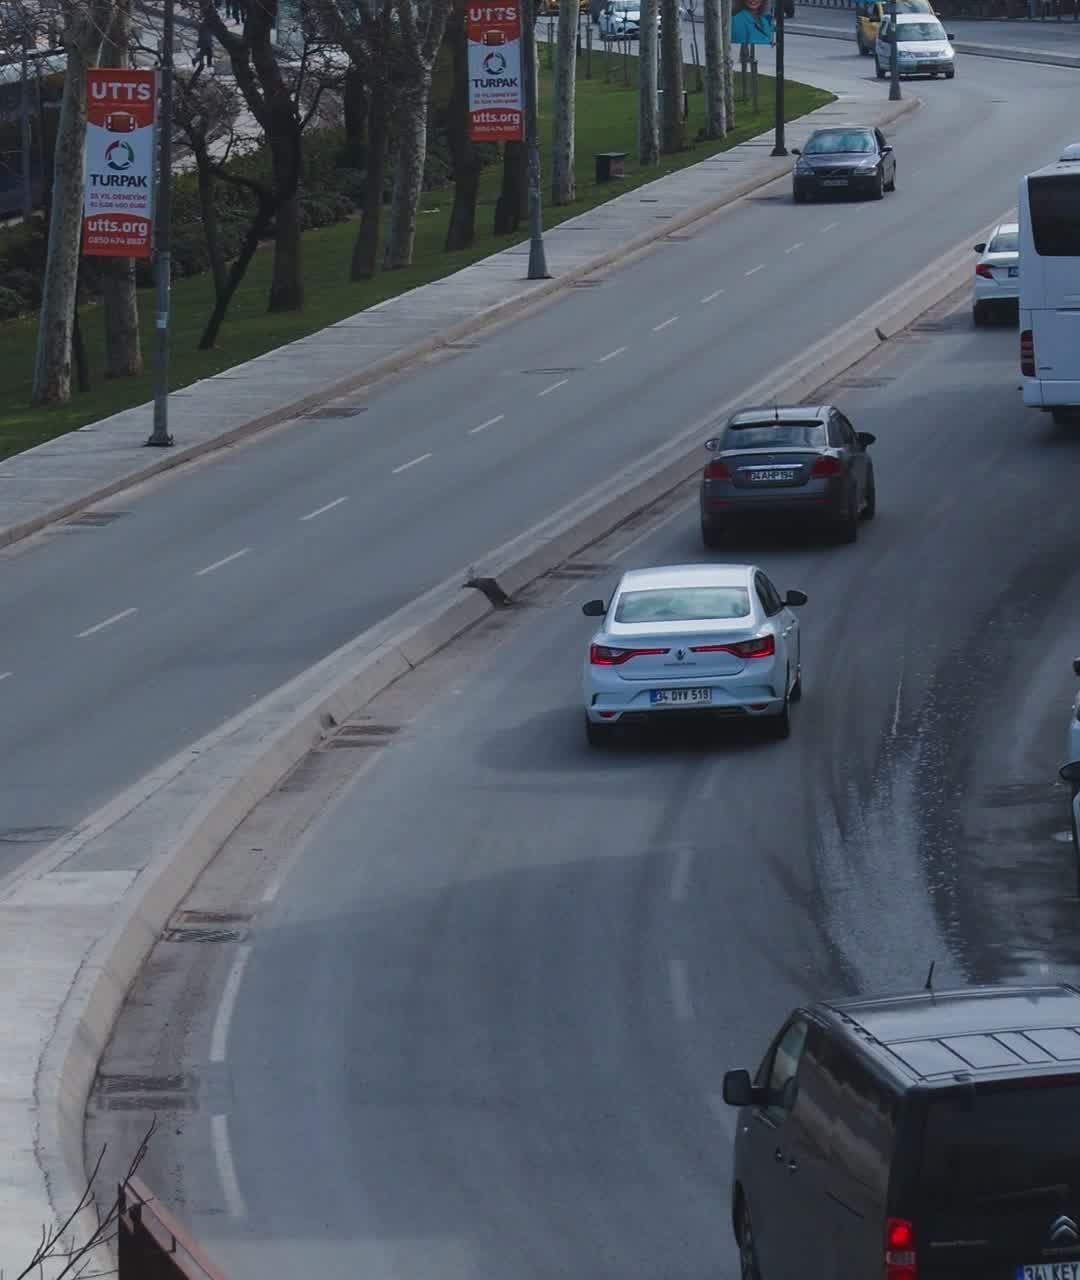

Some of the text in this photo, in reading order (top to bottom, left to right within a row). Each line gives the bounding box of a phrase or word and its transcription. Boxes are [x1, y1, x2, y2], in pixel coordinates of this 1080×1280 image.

[470, 7, 517, 22] UTTS
[472, 78, 519, 89] TURPAK
[91, 82, 152, 100] UTTS
[472, 111, 521, 125] utts.org
[89, 174, 148, 188] TURPAK
[88, 218, 148, 237] utts.org
[656, 690, 669, 702] 34
[1053, 1264, 1078, 1280] KEY
